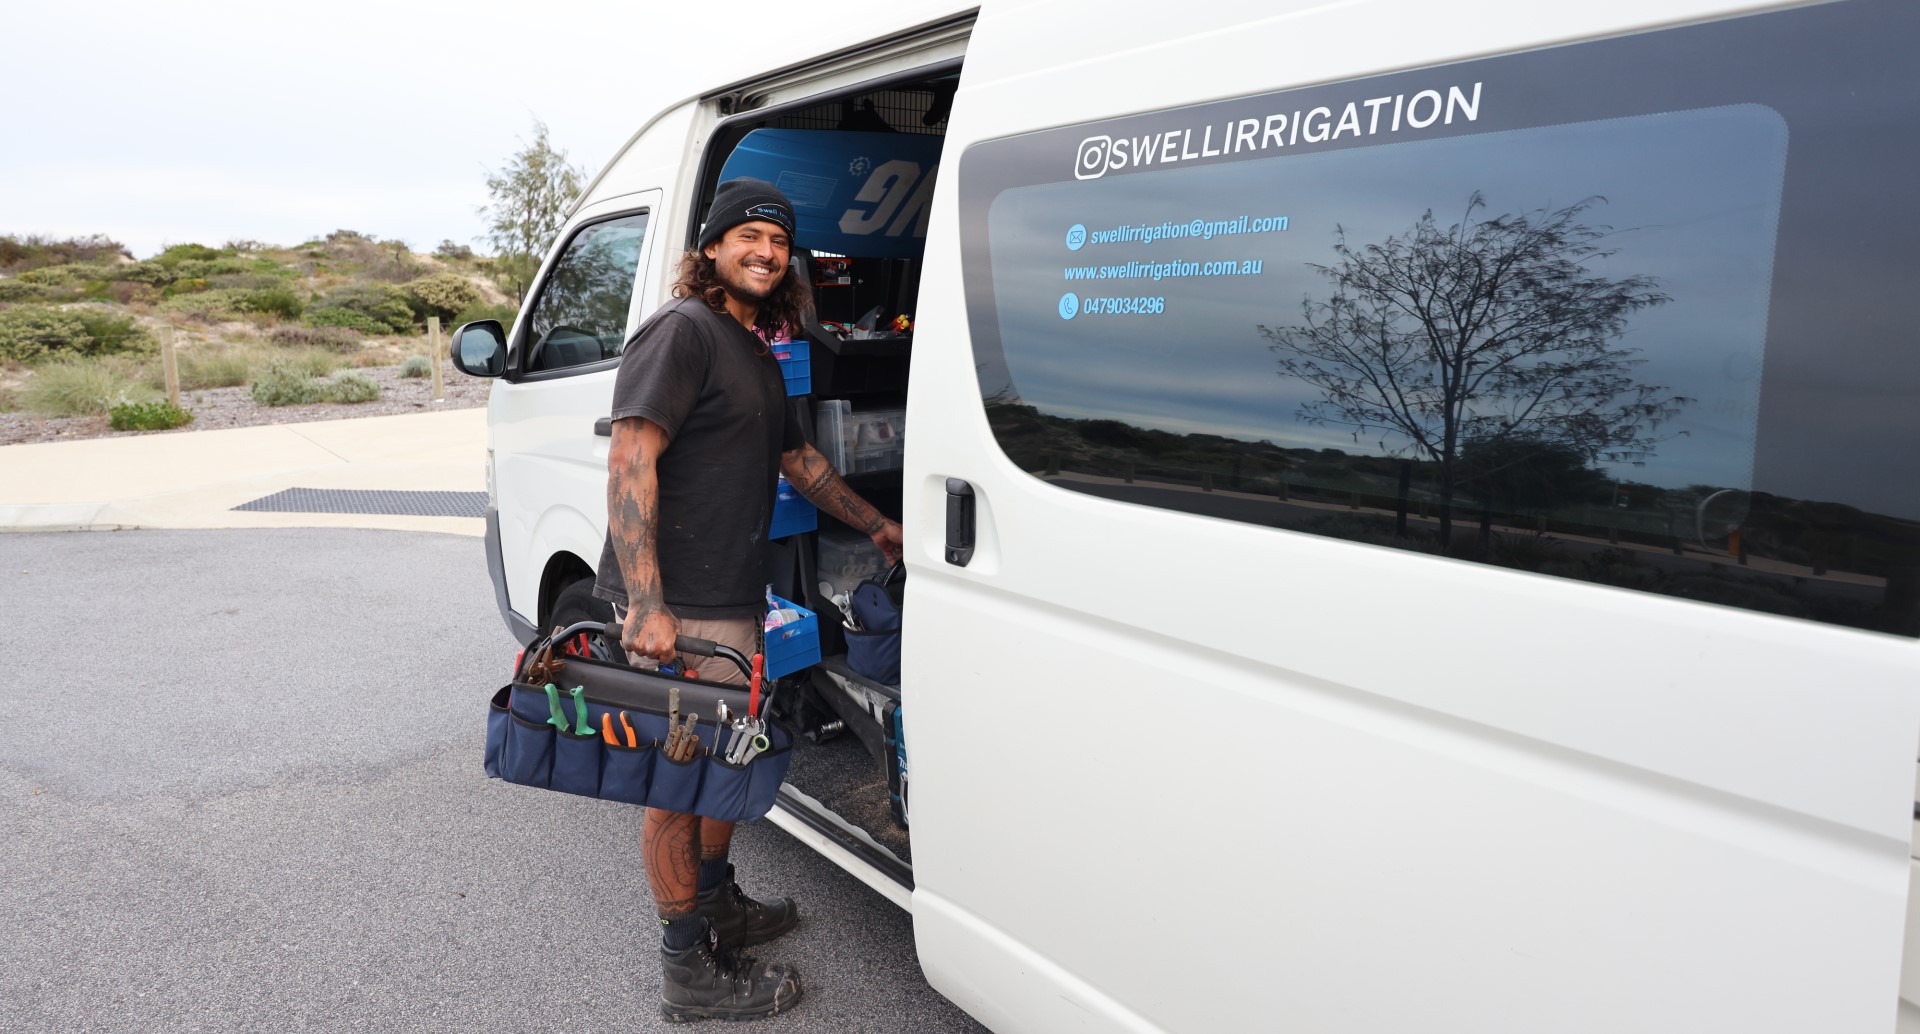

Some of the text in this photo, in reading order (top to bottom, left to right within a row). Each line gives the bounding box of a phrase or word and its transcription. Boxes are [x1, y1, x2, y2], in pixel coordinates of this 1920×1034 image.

[1109, 82, 1482, 170] SWELLIRRIGATION
[1090, 215, 1289, 244] swellirrigation@gmail.com
[1064, 259, 1263, 281] www.swellirrigation.com.au
[1083, 297, 1165, 314] 0479034296
